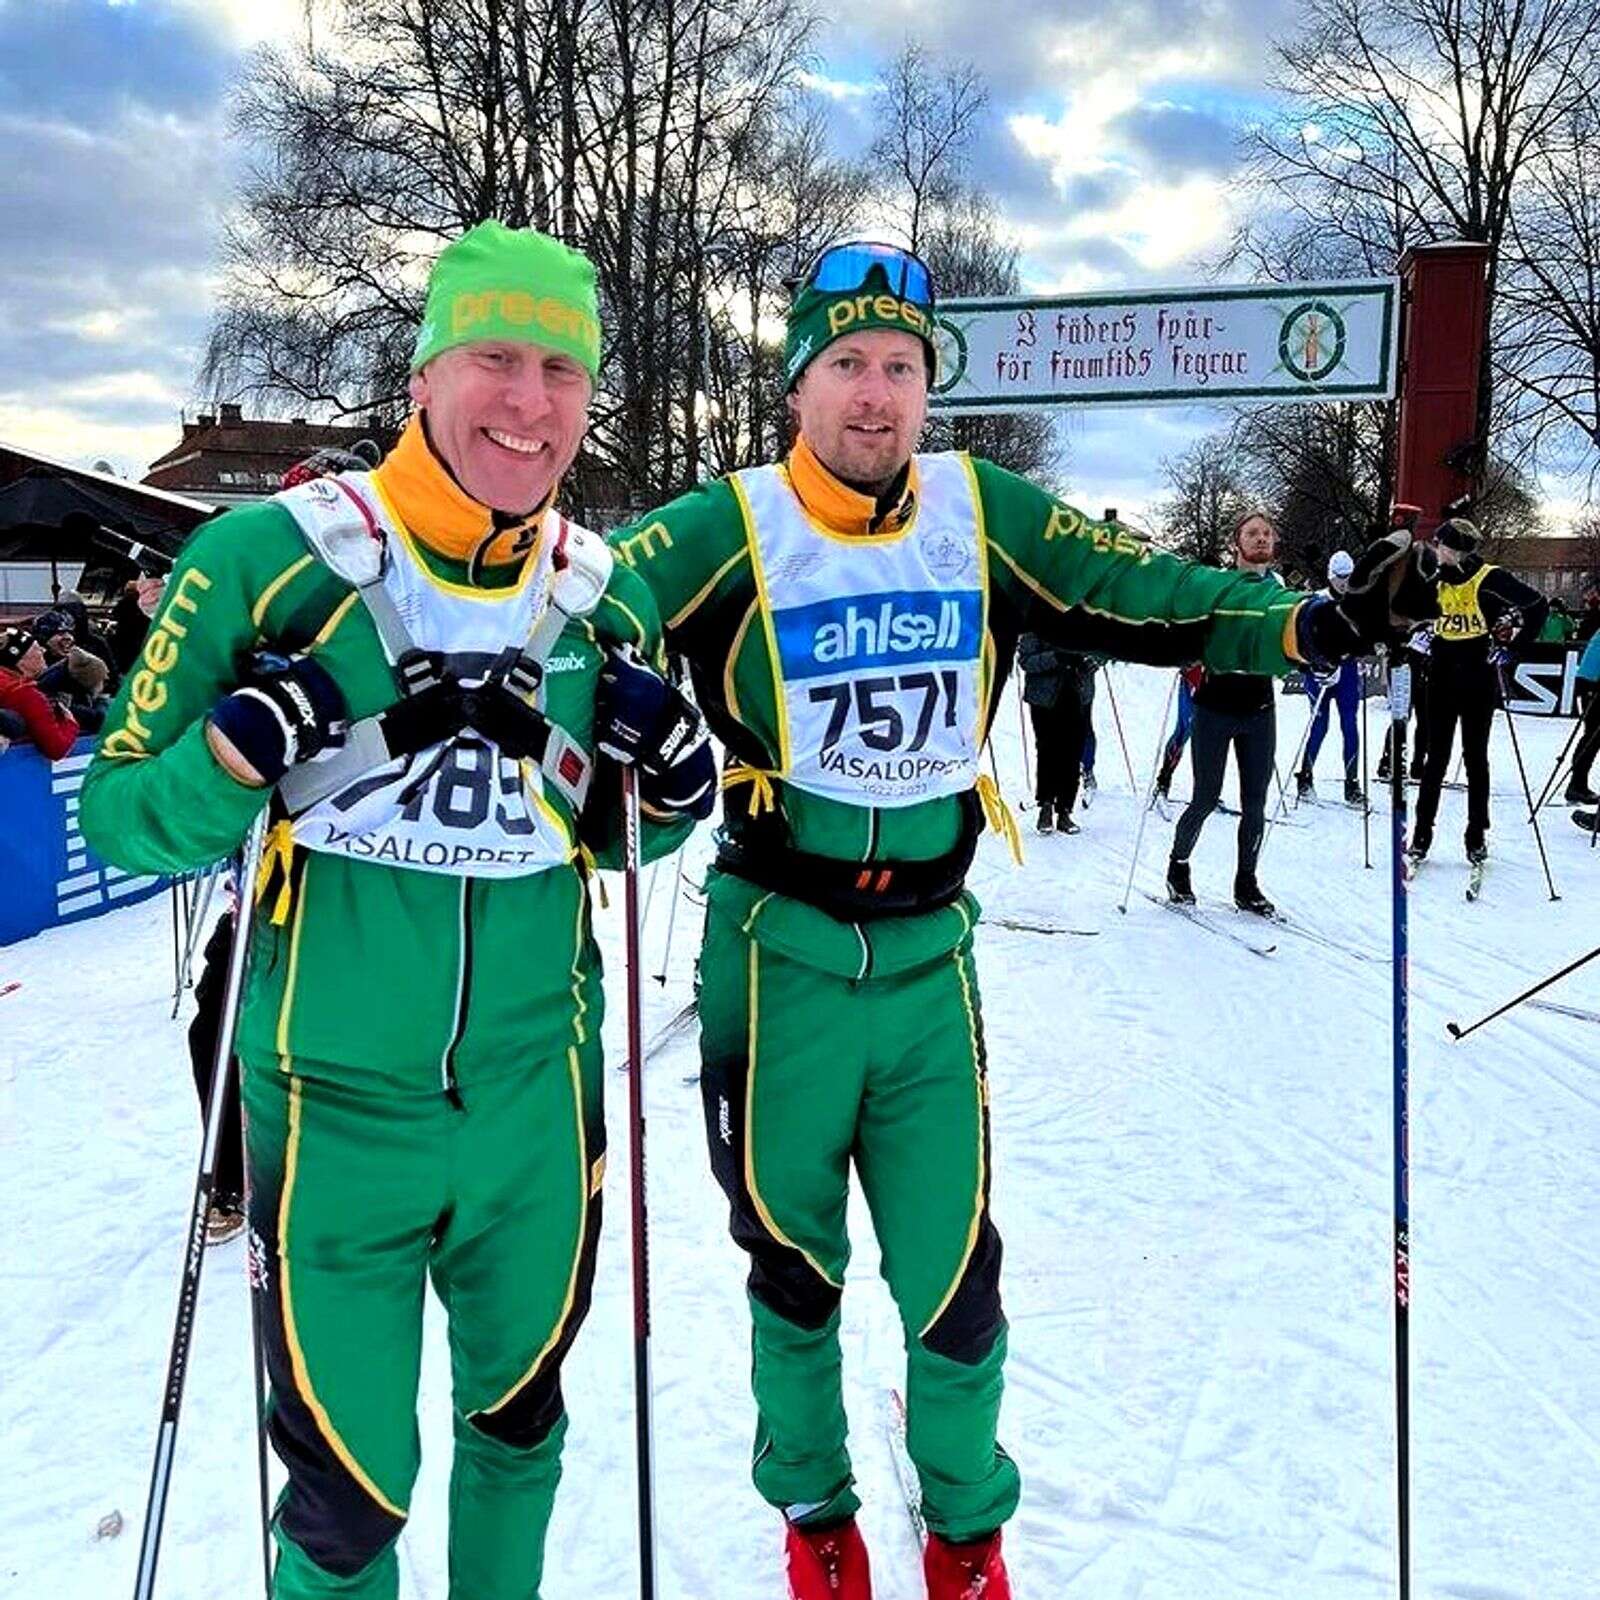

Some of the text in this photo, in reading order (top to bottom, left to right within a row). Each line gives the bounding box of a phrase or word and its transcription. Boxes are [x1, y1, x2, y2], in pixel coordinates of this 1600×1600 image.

[997, 352, 1031, 387] för
[1051, 346, 1153, 388] framtids
[101, 567, 212, 759] preem
[813, 600, 961, 663] ahlsell
